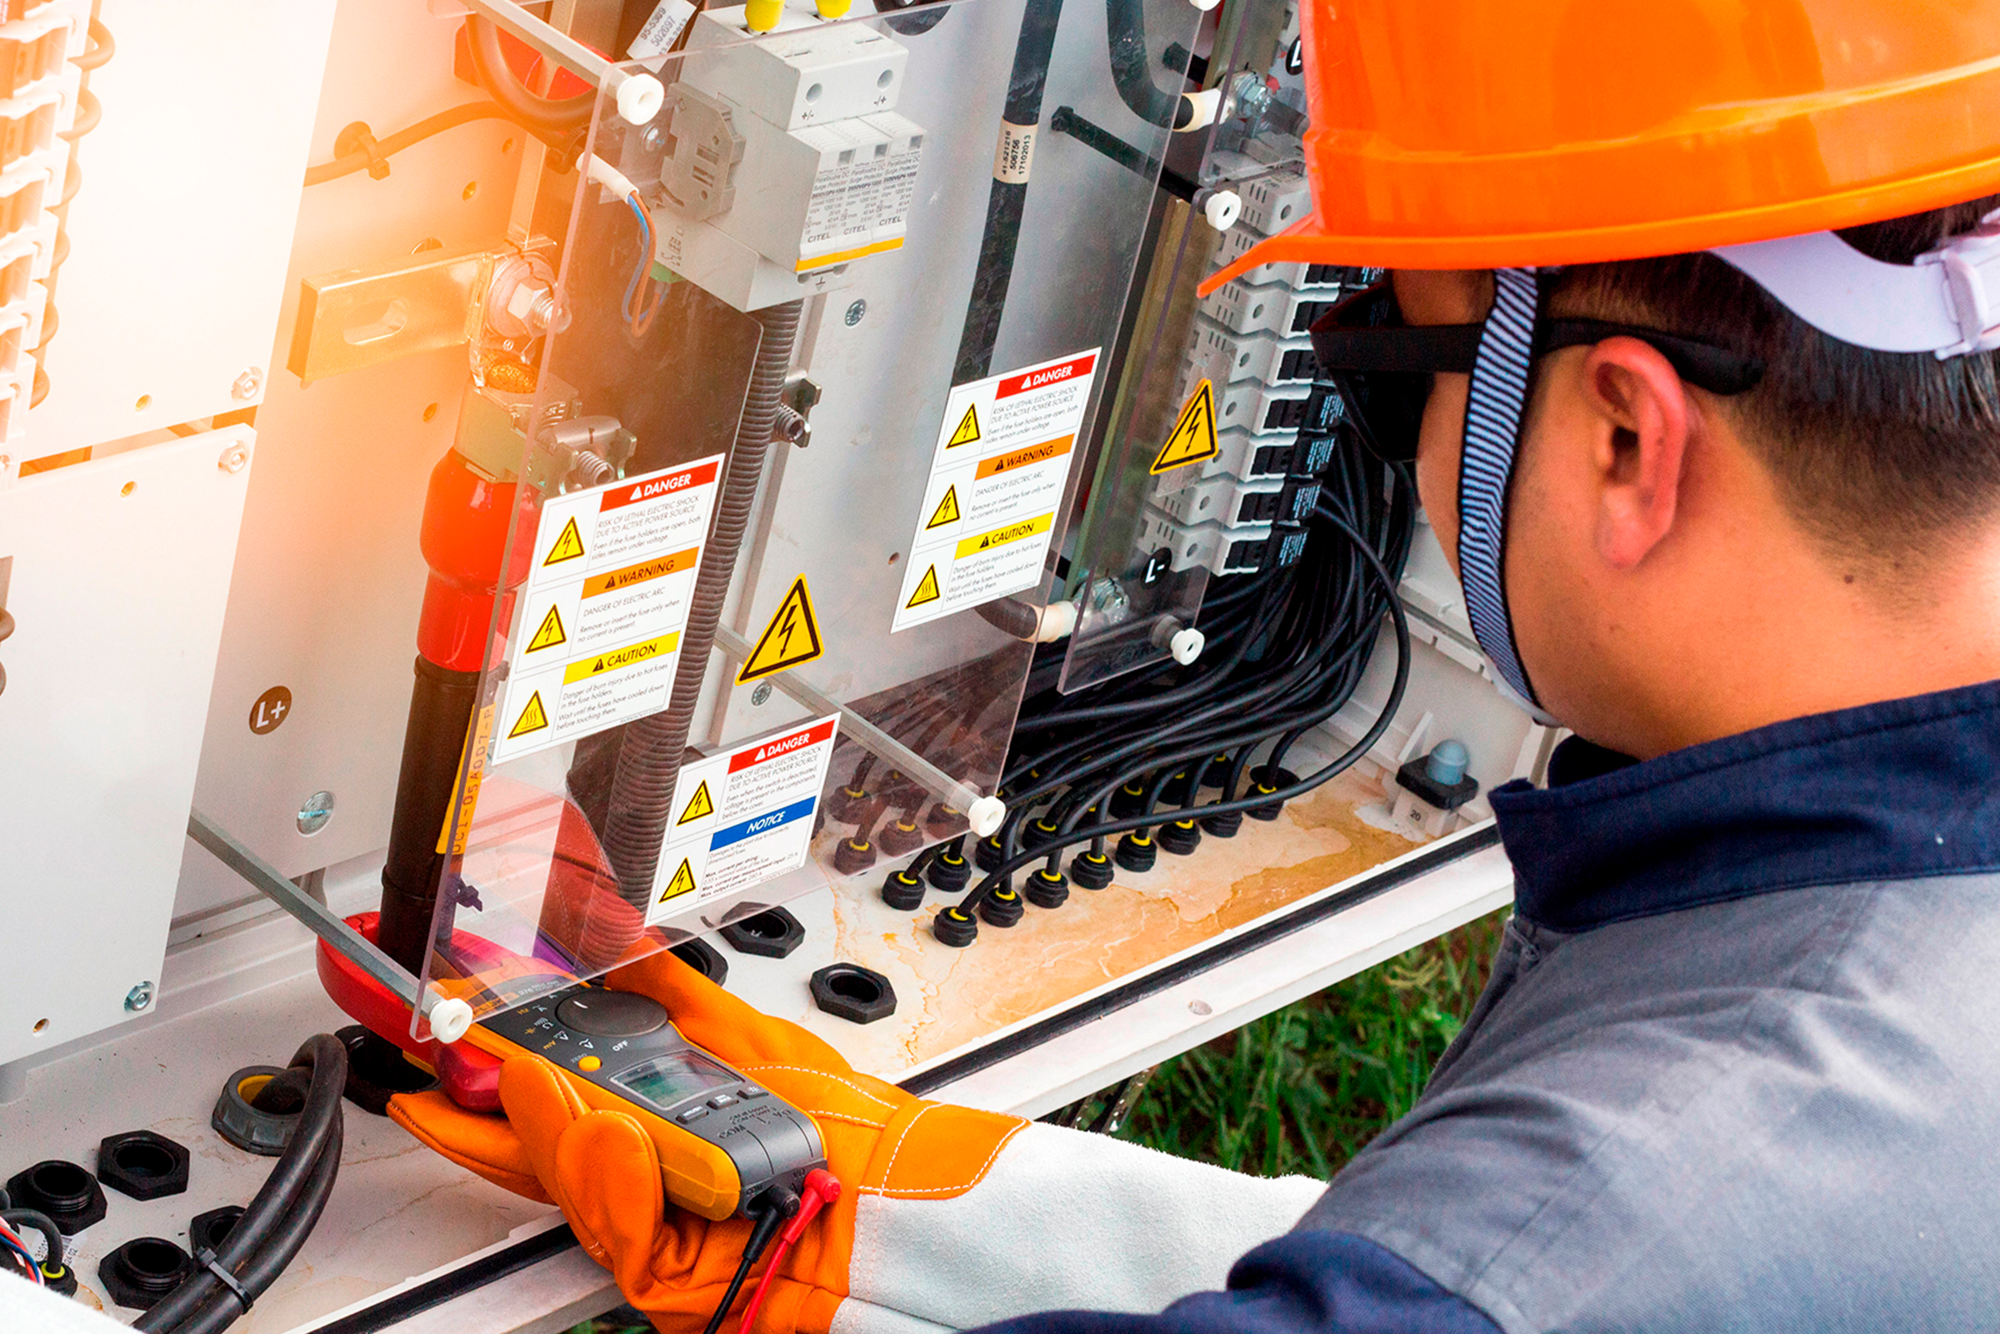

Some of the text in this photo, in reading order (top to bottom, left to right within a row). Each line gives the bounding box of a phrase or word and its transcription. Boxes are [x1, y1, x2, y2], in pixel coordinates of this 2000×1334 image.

[1010, 139, 1020, 170] 506756
[1018, 134, 1031, 175] 17102013
[843, 224, 867, 236] CITEL
[879, 215, 902, 226] CITEL
[807, 232, 831, 243] CITEL
[1033, 366, 1073, 386] DANGER
[1007, 446, 1053, 467] WARNING
[644, 474, 691, 497] DANGER
[596, 504, 696, 539] DUE TO ACTIVE POWER SOURCE
[599, 496, 699, 528] RISK OF LETHAL ELECTRIC SHOCK
[594, 543, 608, 551] Even
[609, 539, 614, 547] if
[638, 529, 659, 538] holders
[688, 516, 701, 525] both
[992, 523, 1034, 544] CAUTION
[592, 552, 606, 560] sides
[608, 546, 627, 555] remain
[629, 541, 645, 550] under
[620, 560, 674, 584] WARNING
[1145, 558, 1166, 584] L-
[583, 587, 665, 617] DANGER OF ELECTRIC ARC
[580, 623, 603, 633] Remove
[612, 615, 627, 624] insert
[651, 603, 664, 613] only
[665, 600, 680, 608] when
[587, 629, 608, 641] current
[607, 643, 657, 667] CAUTION
[563, 690, 585, 701] Danger
[586, 685, 593, 694] of
[593, 683, 607, 691] burn
[608, 678, 624, 687] injury
[654, 664, 668, 672] fuses
[256, 700, 286, 728] L+
[559, 712, 573, 721] Wait
[574, 707, 586, 717] until
[598, 701, 611, 709] fuses
[613, 696, 627, 704] have
[628, 688, 648, 700] cooled
[648, 684, 664, 694] down
[556, 721, 575, 731] before
[577, 713, 601, 724] touching
[768, 733, 810, 757] DANGER
[747, 812, 785, 834] NOTICE
[1410, 809, 1421, 821] 20
[612, 1040, 629, 1052] OFF
